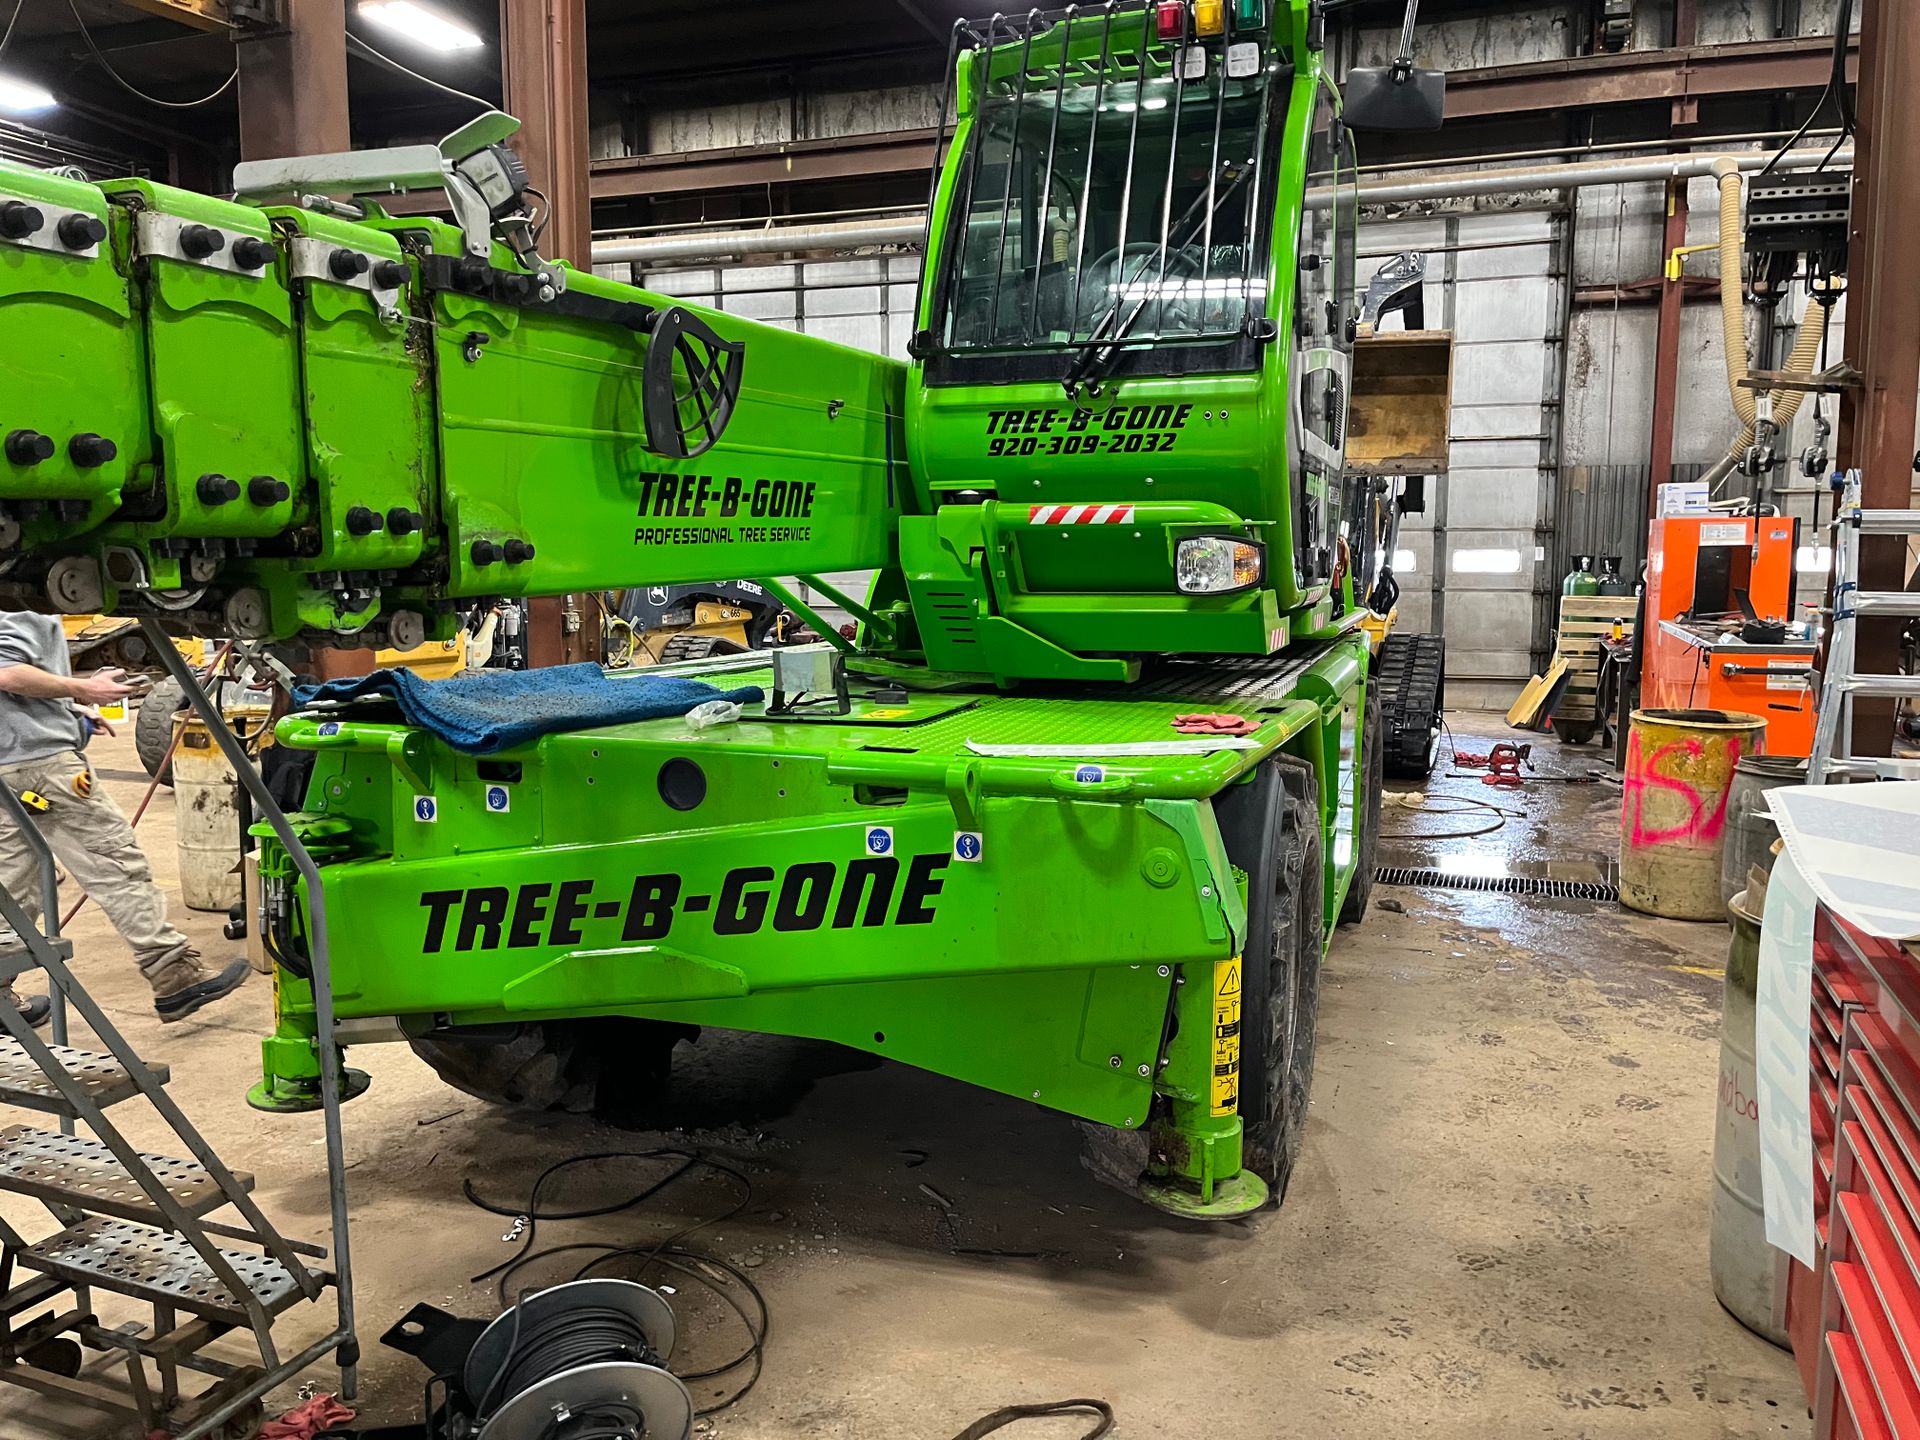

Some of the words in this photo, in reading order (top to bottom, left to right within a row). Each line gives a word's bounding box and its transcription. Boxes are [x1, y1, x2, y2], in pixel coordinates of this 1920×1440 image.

[986, 404, 1194, 435] TREE-B-GONE
[987, 433, 1177, 456] 920-309-2032
[637, 472, 817, 518] TREE-B-GONE
[634, 527, 734, 545] PROFESSIONAL
[739, 527, 767, 543] TREE
[769, 526, 811, 542] SERVICE
[737, 579, 763, 596] DEERE
[419, 852, 952, 954] TREE-B-GONE
